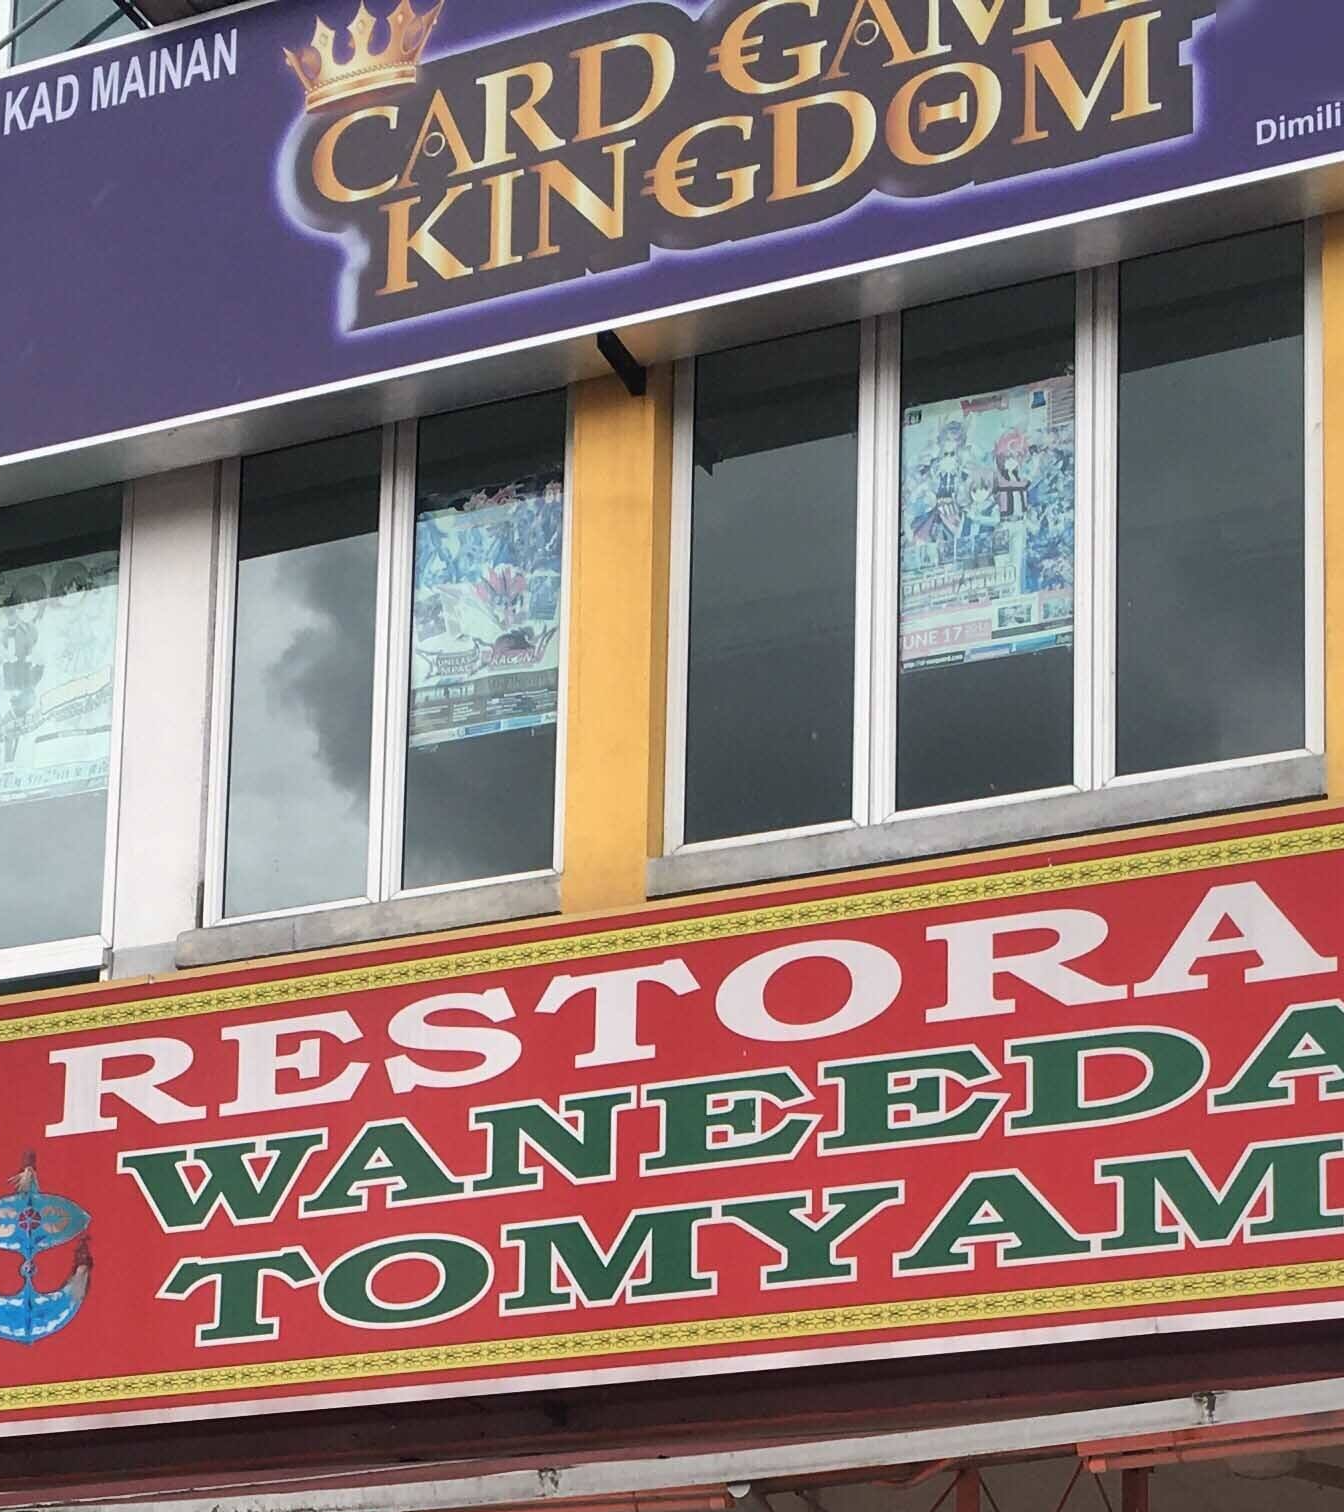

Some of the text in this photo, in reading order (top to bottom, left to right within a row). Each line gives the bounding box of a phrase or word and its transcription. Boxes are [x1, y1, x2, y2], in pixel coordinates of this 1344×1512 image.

[3, 74, 80, 137] KAD
[90, 28, 239, 113] MAINAN
[312, 0, 1154, 203] CARD GAM
[376, 10, 1162, 298] KINGDOM
